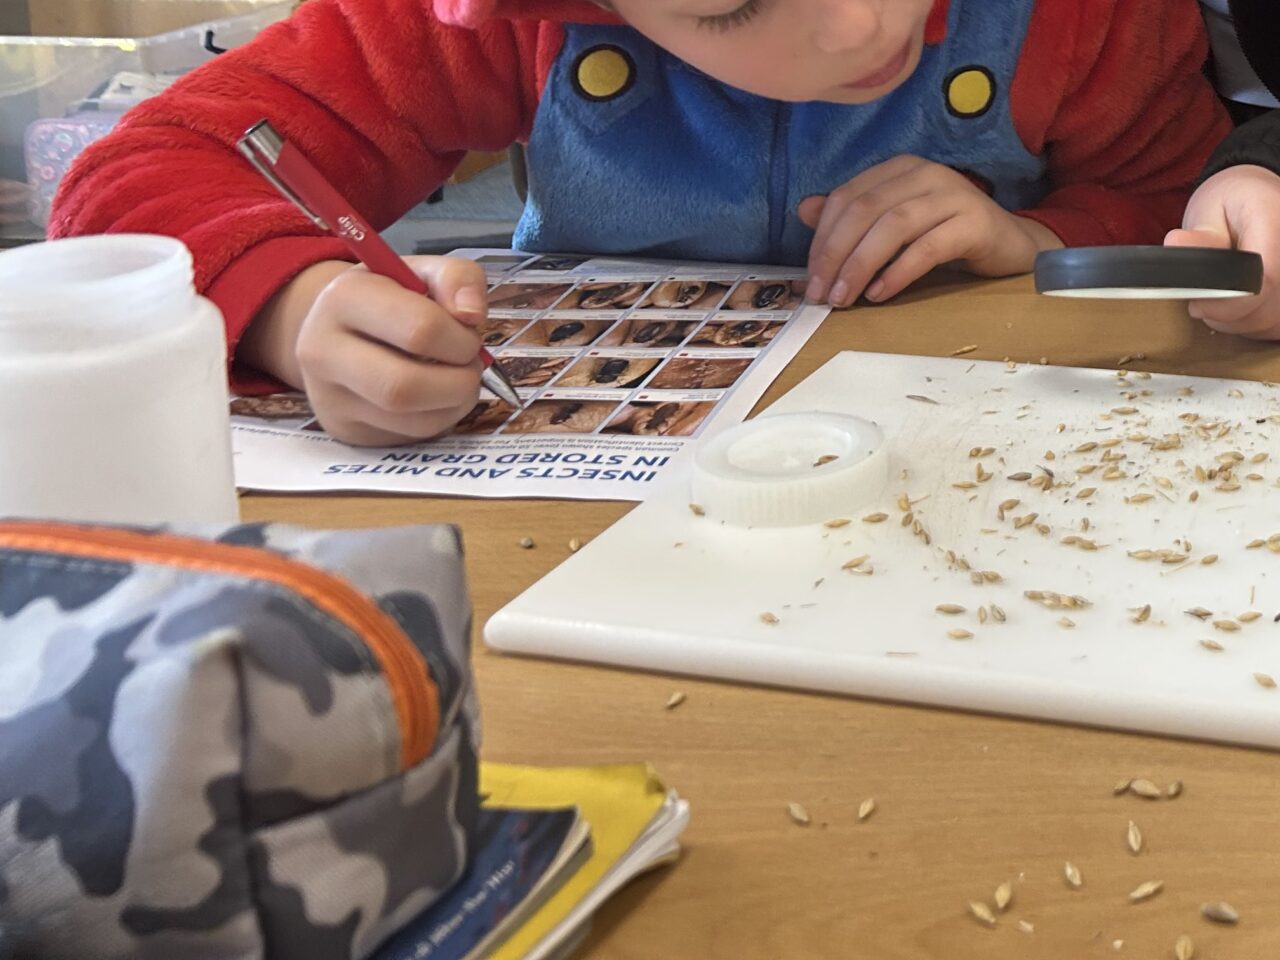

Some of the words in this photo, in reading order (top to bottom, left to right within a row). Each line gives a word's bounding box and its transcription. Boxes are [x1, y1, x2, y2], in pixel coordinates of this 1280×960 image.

[380, 452, 488, 464] GRAIN
[495, 452, 628, 466] STORED
[632, 456, 670, 467] IN
[322, 463, 430, 476] MITES
[435, 466, 512, 480] AND
[516, 467, 657, 482] INSECTS
